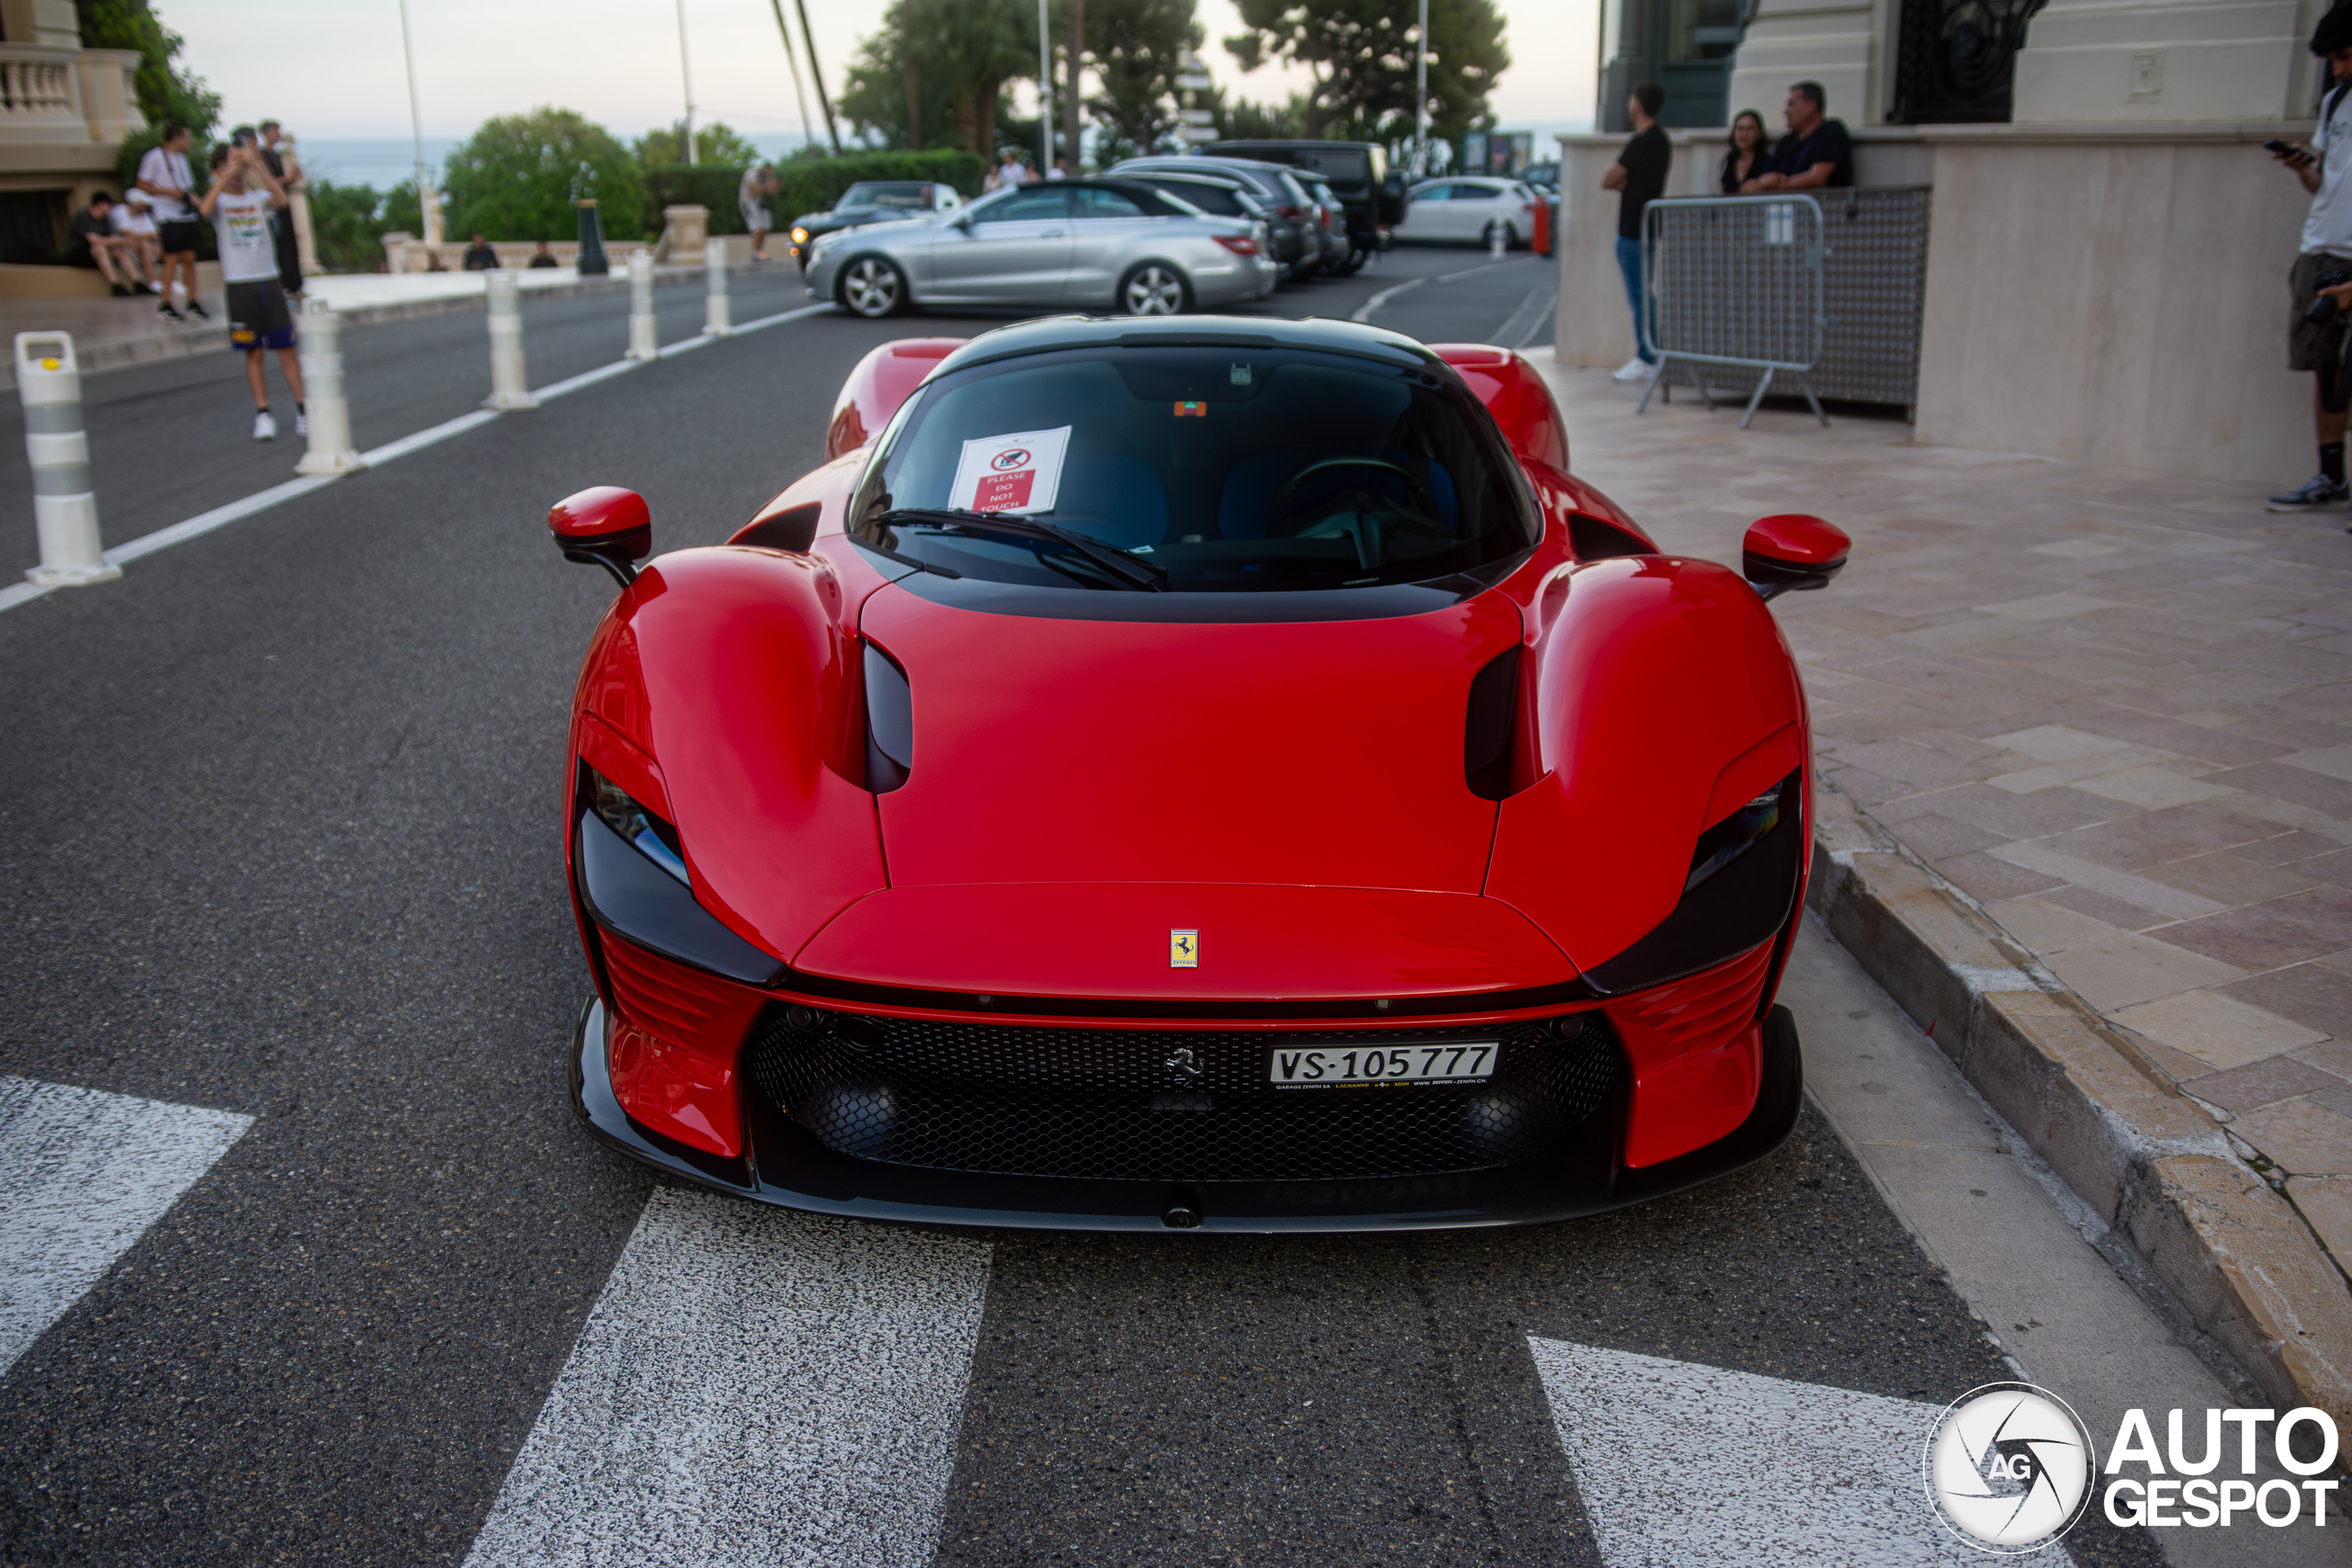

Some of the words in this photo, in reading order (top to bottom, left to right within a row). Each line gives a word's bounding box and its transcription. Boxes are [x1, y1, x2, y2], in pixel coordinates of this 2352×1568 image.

[988, 472, 1025, 483] PLEASE
[995, 483, 1012, 491] DO
[989, 491, 1014, 502] NOT
[980, 501, 1018, 512] TOUCH
